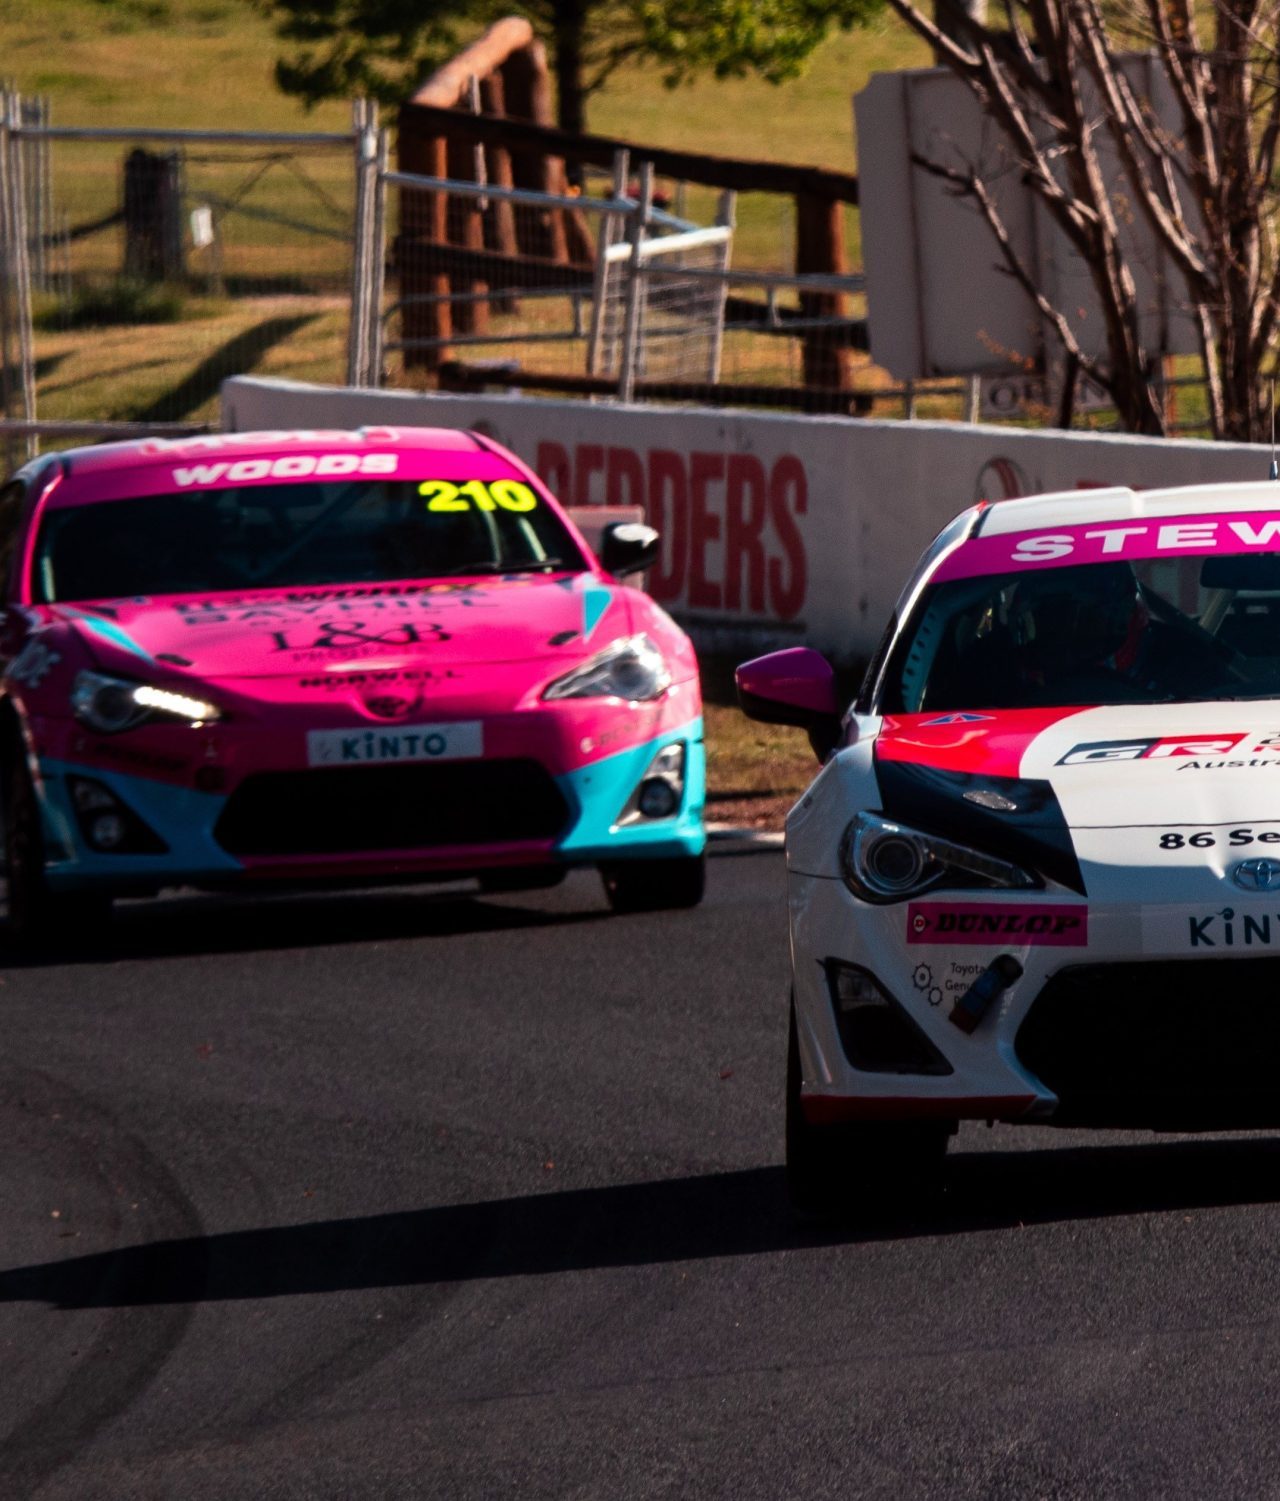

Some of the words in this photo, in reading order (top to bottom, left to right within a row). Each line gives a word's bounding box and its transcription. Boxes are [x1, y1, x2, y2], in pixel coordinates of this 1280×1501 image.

[172, 453, 399, 486] WOODS
[418, 479, 537, 512] 210
[1059, 737, 1240, 766] GR
[1158, 833, 1216, 850] 86
[933, 913, 1082, 934] DUNLOP
